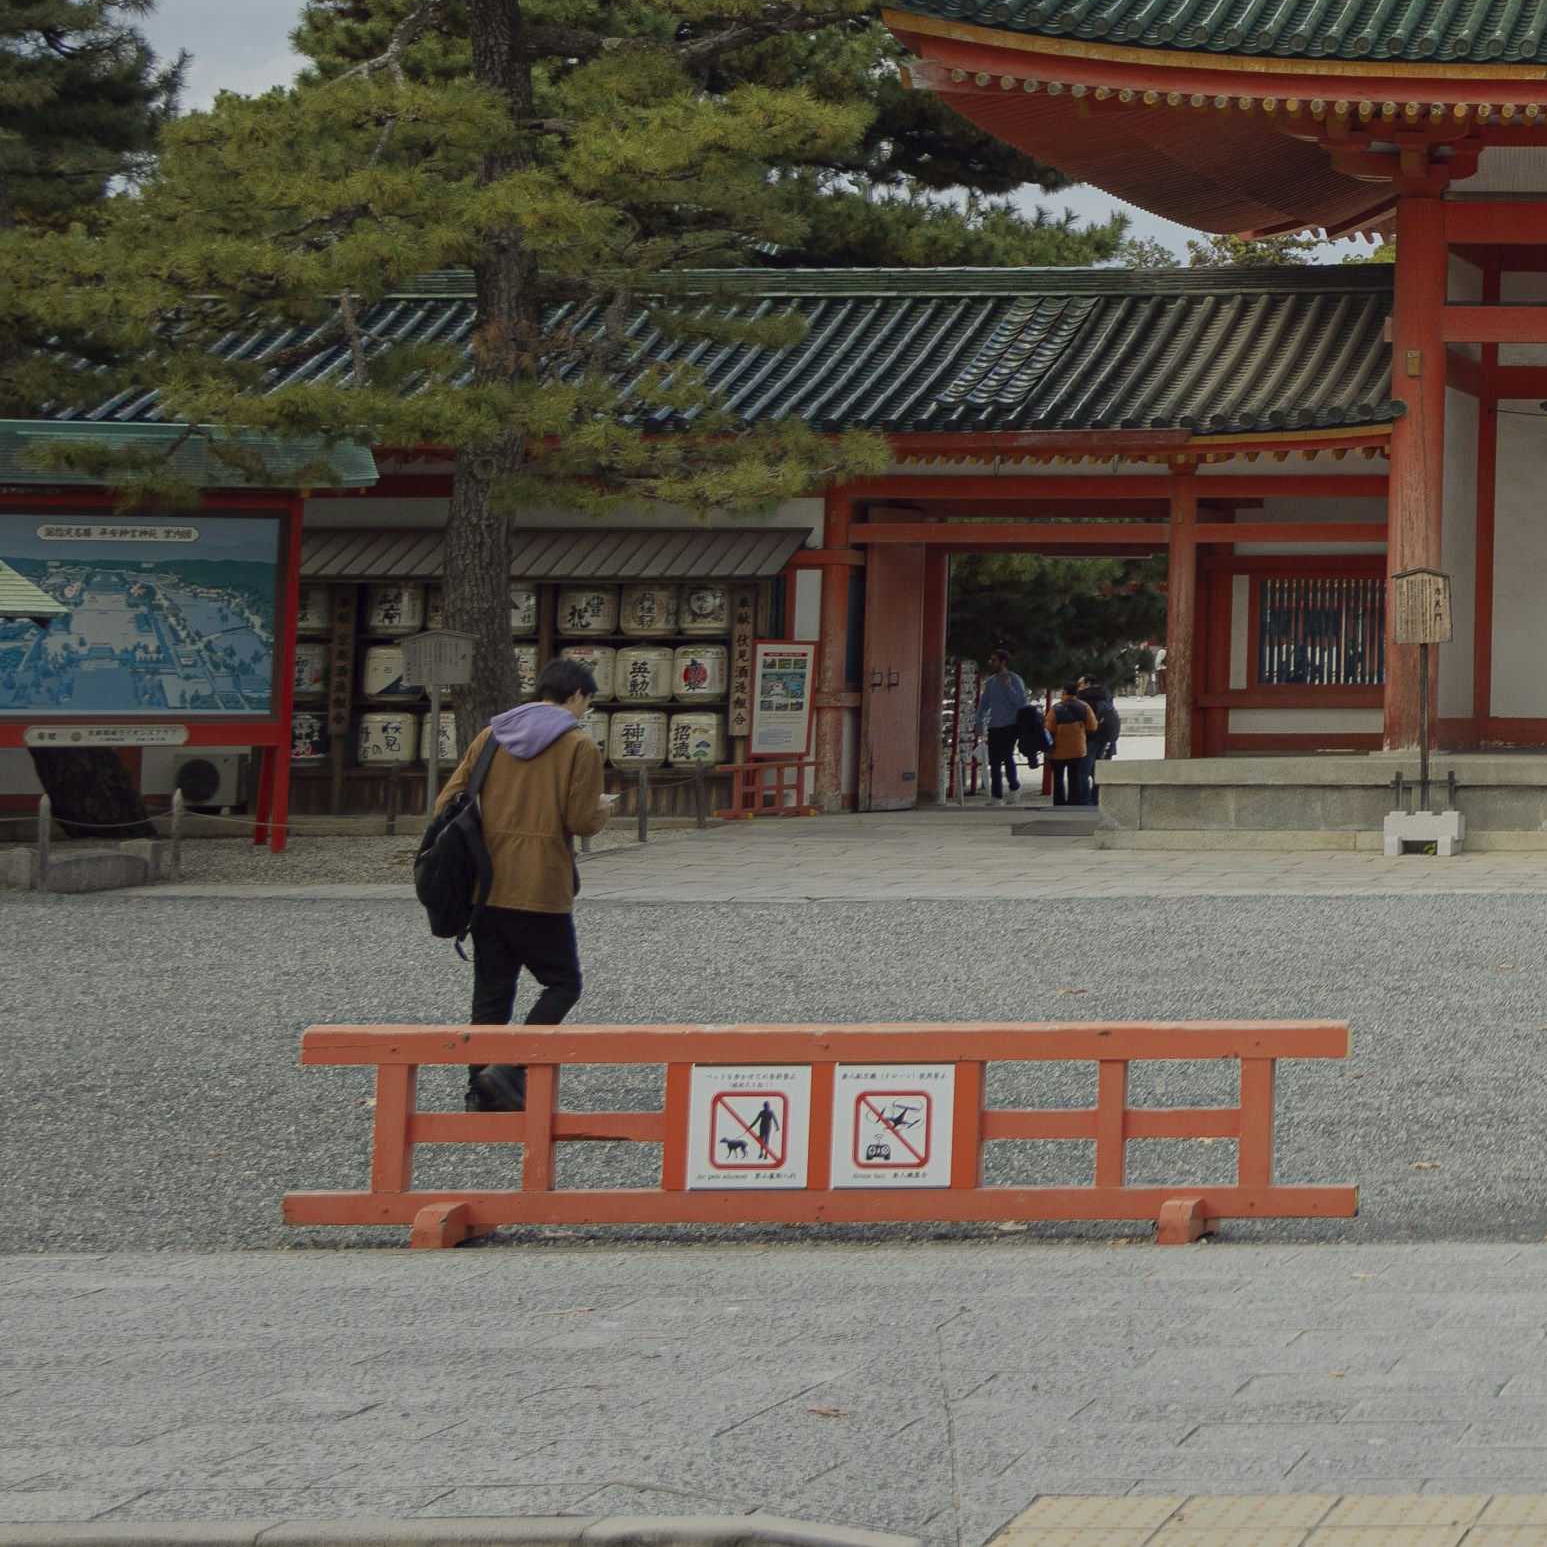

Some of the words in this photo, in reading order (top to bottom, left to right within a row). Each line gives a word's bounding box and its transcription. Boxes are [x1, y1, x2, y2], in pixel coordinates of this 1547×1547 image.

[733, 634, 750, 725] 伏見酒造組合
[622, 723, 646, 758] 神聖
